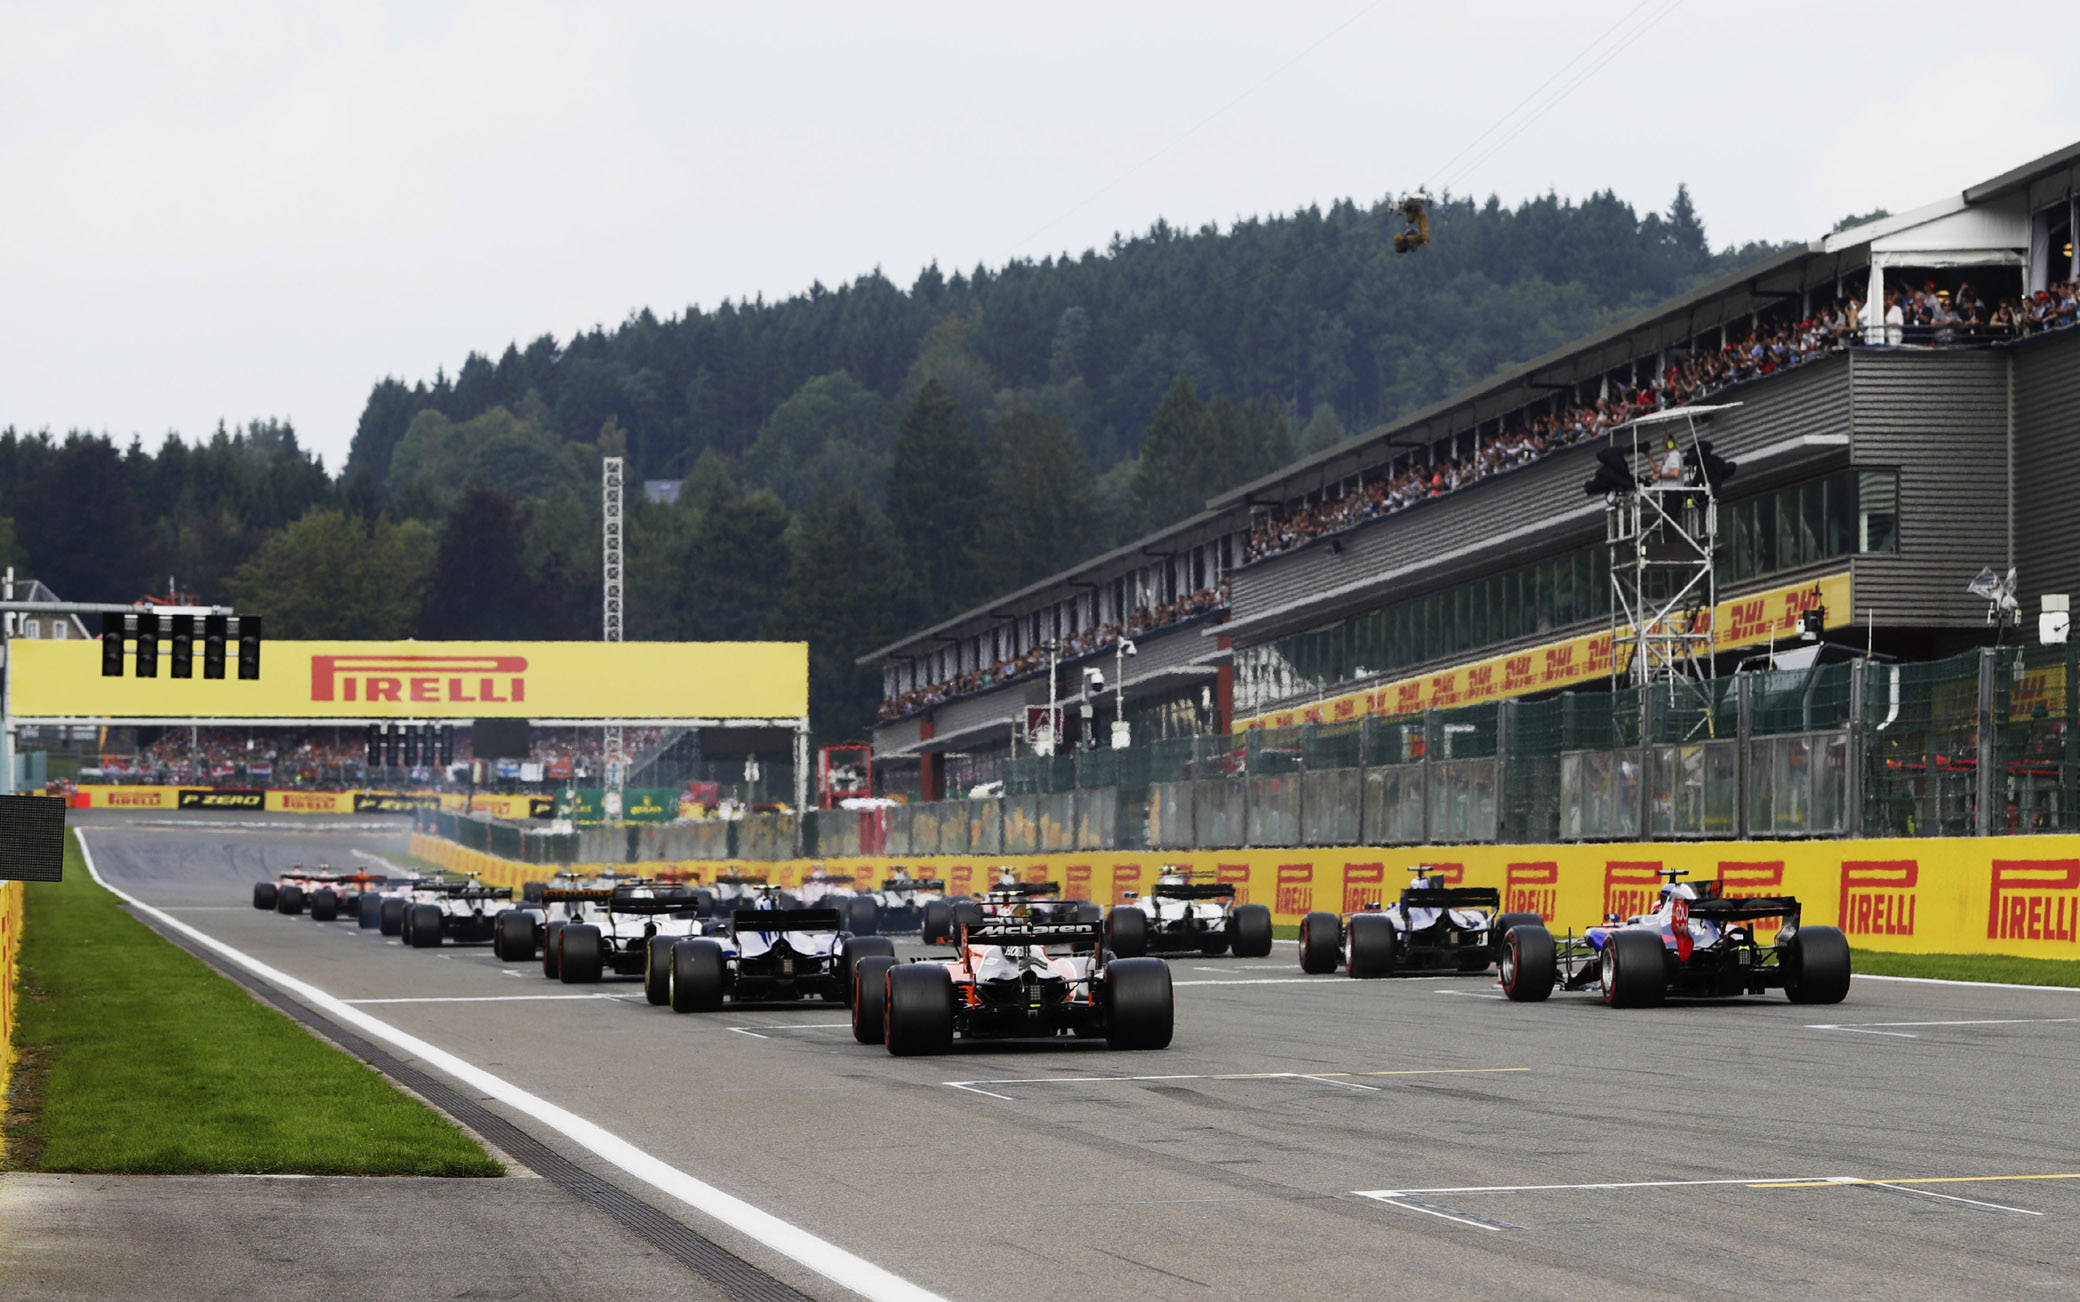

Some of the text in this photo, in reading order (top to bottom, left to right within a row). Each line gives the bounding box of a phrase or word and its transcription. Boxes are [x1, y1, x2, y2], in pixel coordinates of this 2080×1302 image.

[1730, 599, 1767, 641] DHL
[311, 655, 529, 702] PIRELLI
[183, 795, 260, 806] P ZERO
[1275, 863, 1313, 915] PIRELLI
[1505, 861, 1558, 923] PIRELLI
[1837, 860, 1919, 936] PIRELLI
[1987, 858, 2080, 943] PIRELLI
[974, 924, 1093, 936] McLaren
